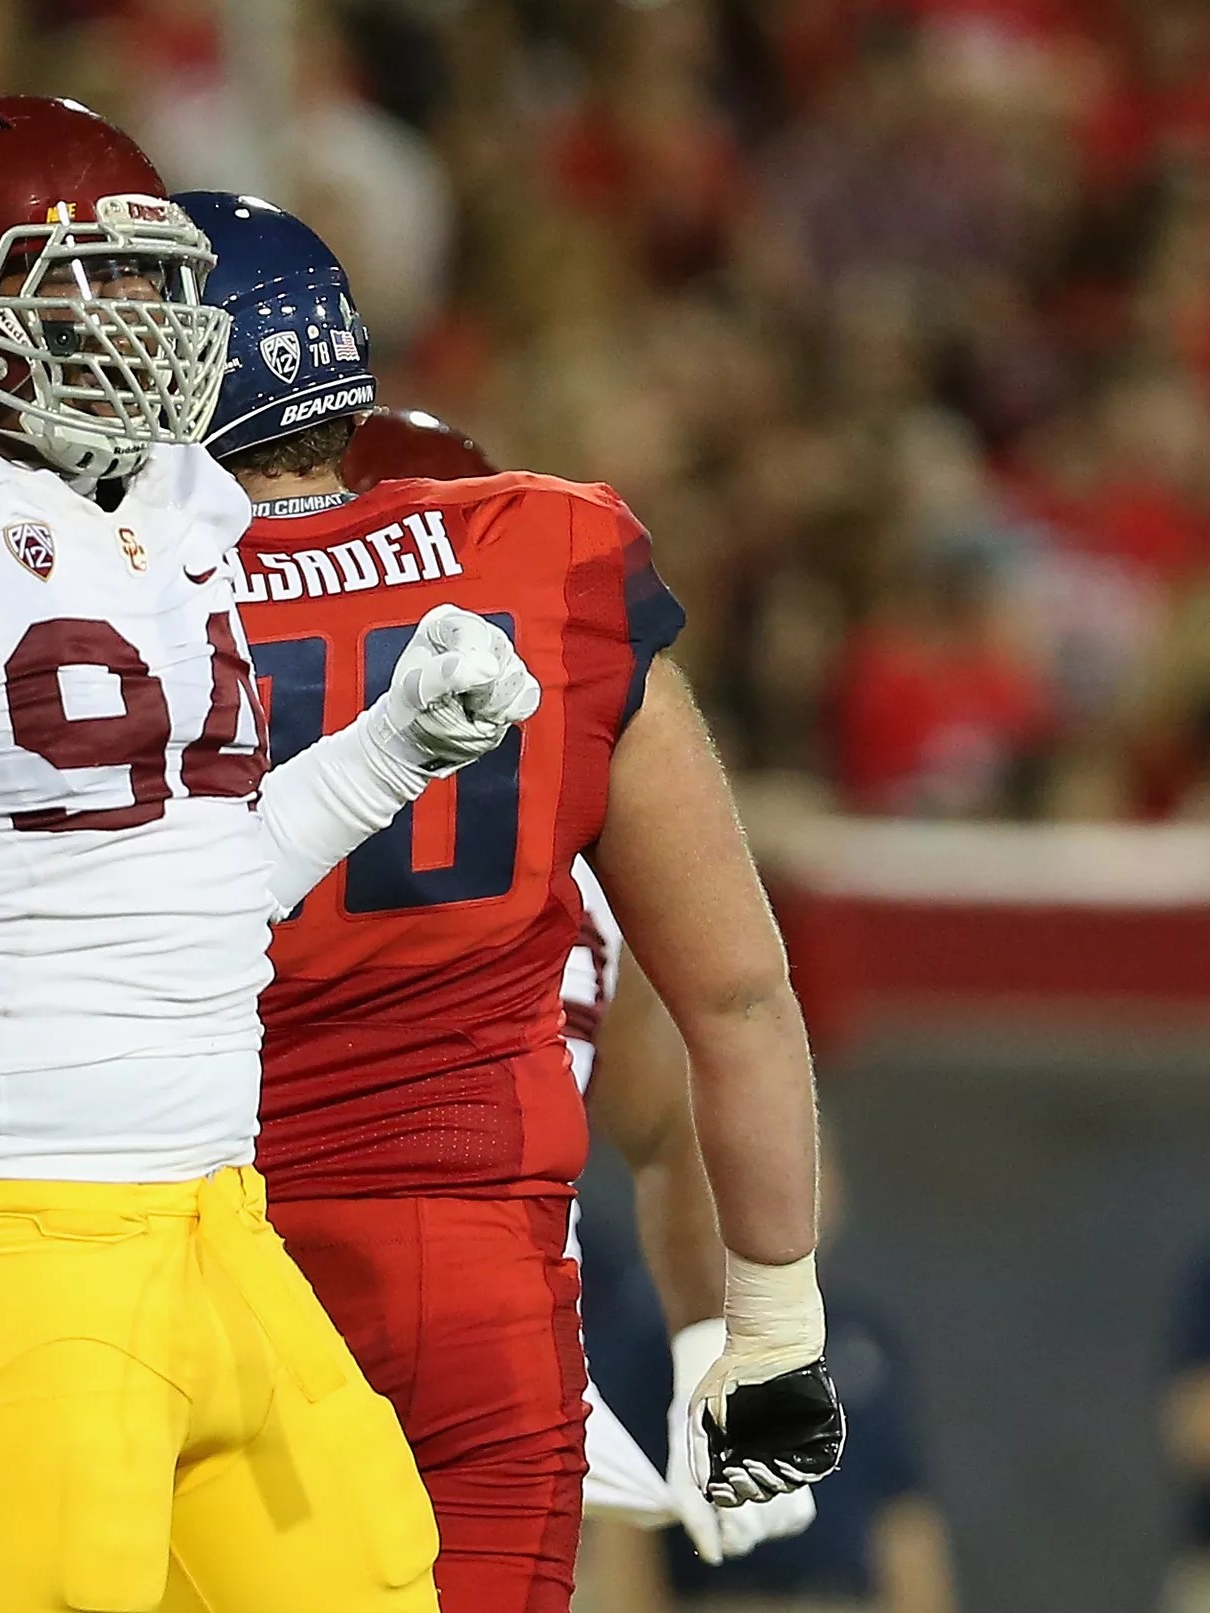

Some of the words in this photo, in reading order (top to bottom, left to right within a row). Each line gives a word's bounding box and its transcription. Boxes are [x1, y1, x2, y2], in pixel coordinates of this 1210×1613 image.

[276, 353, 295, 374] 12
[309, 341, 331, 367] 78
[280, 385, 374, 426] BEARDOWN
[274, 493, 345, 515] COMBAT
[8, 525, 52, 559] PAC
[24, 546, 52, 568] 12
[118, 527, 148, 571] SC
[224, 511, 463, 602] LSADEK
[4, 611, 271, 832] 94
